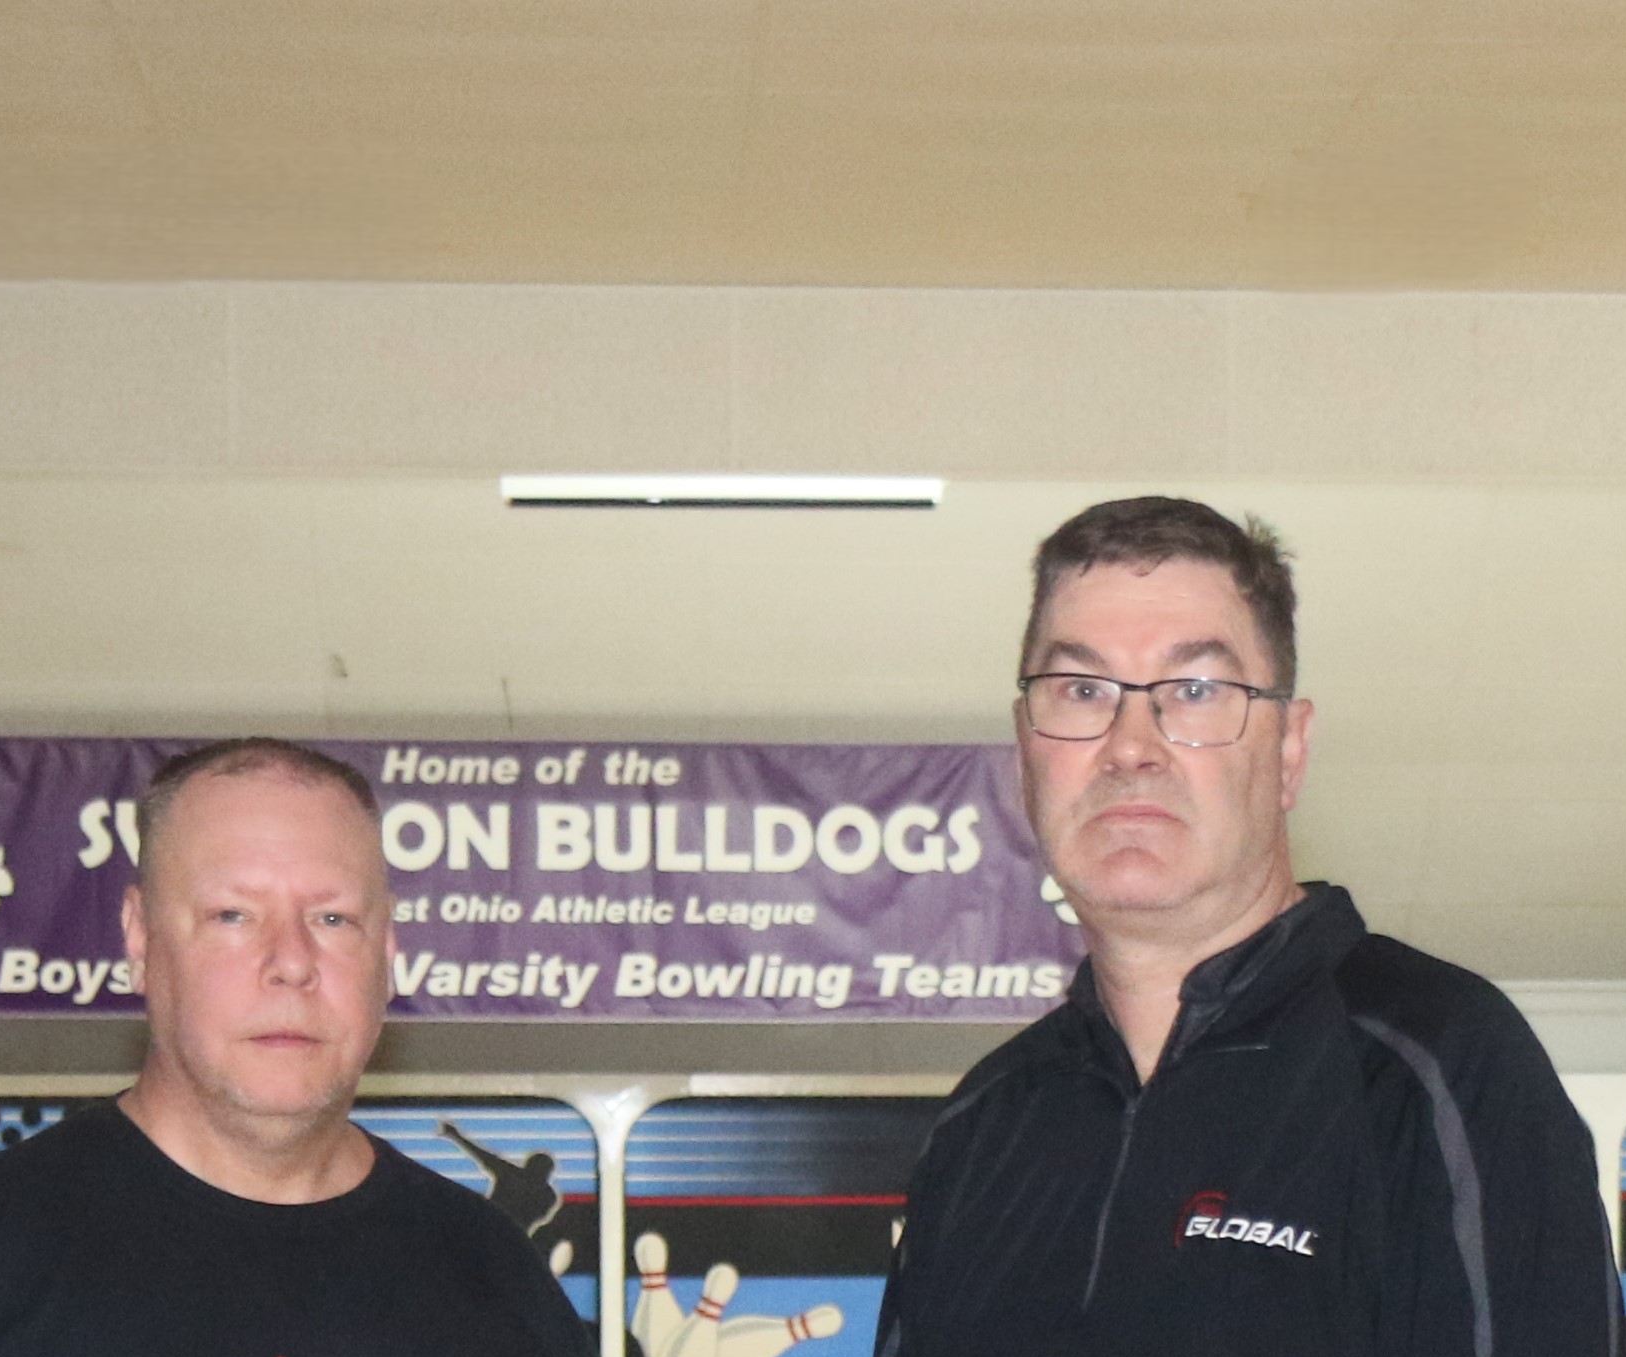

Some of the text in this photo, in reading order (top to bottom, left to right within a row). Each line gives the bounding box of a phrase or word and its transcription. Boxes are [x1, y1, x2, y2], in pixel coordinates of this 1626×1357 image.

[381, 748, 681, 787] Home of the
[536, 804, 982, 875] BULLDOGS
[439, 893, 522, 925] Ohio
[530, 895, 674, 926] Athletic
[684, 897, 817, 930] League
[391, 952, 598, 1007] Varsity
[615, 954, 853, 1008] Bowling
[873, 955, 1064, 999] Teams
[1185, 1216, 1314, 1256] GLOBAL
